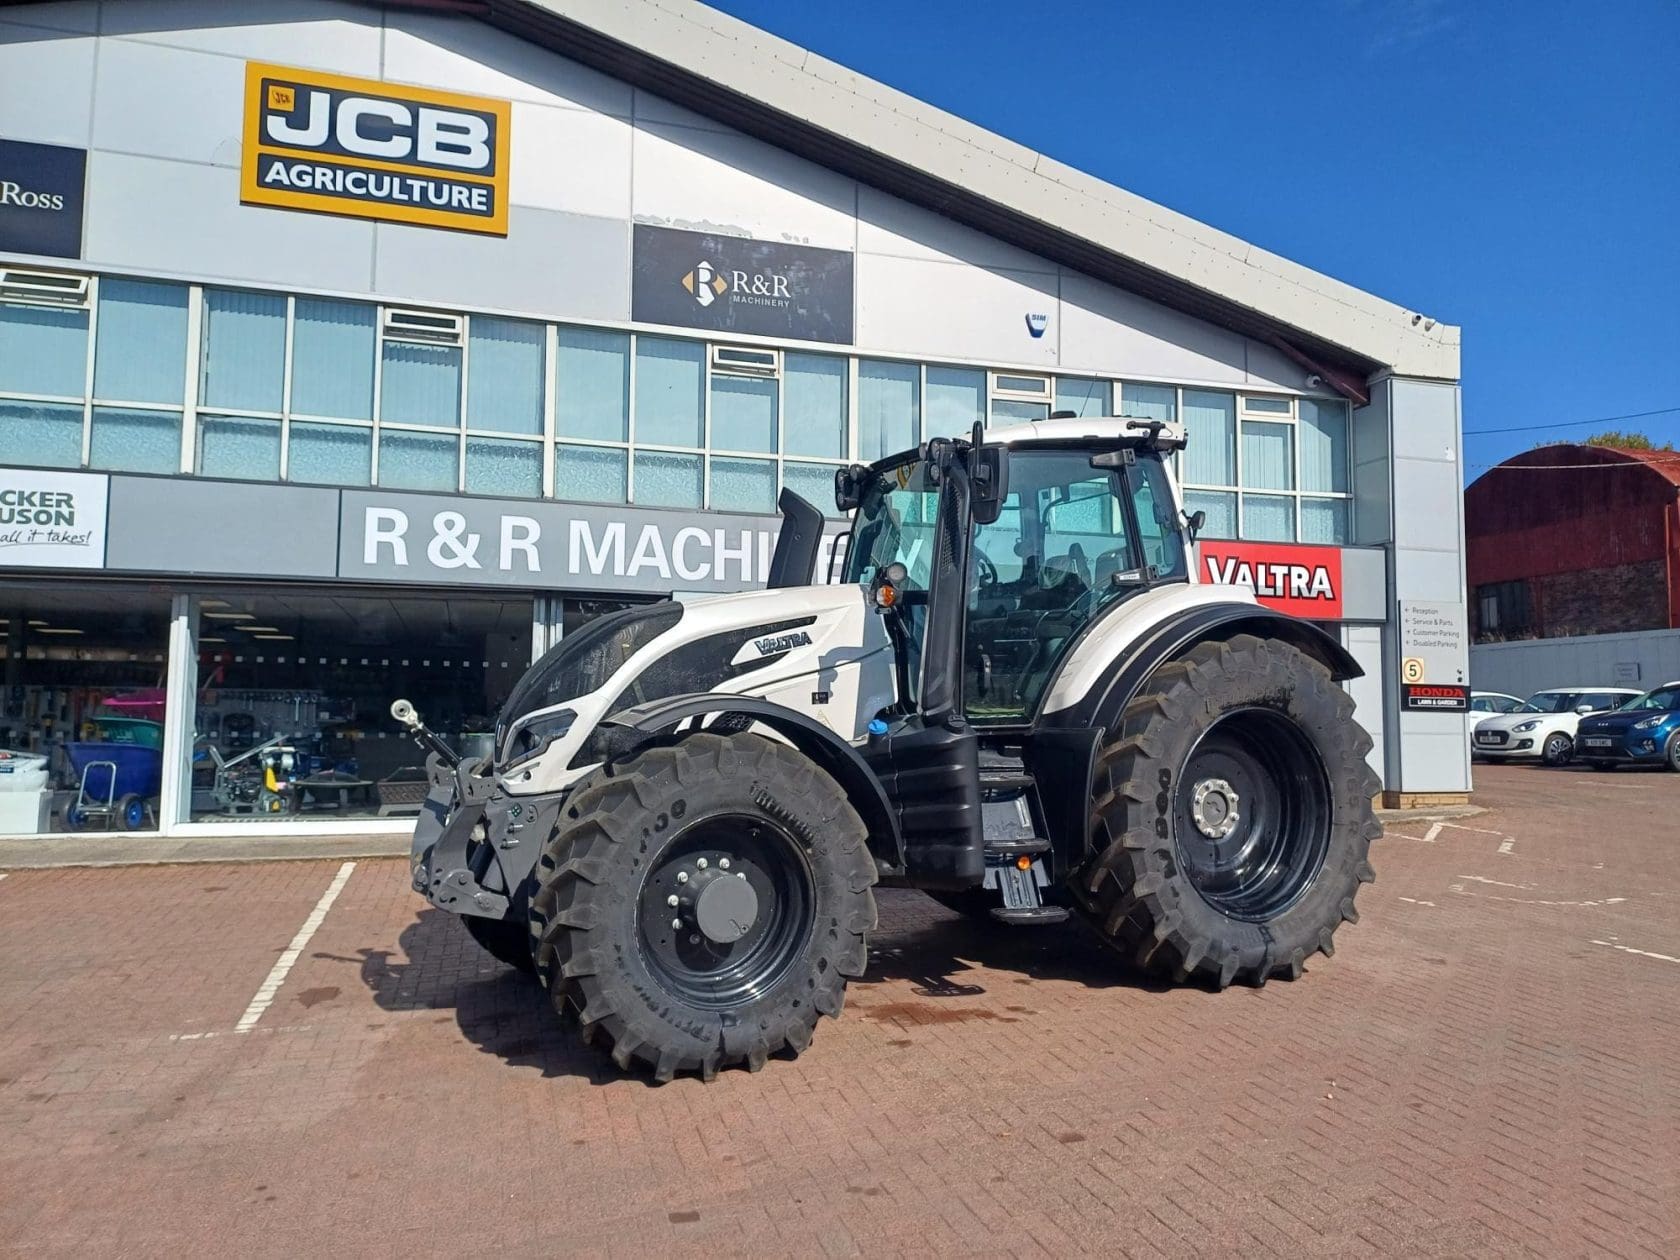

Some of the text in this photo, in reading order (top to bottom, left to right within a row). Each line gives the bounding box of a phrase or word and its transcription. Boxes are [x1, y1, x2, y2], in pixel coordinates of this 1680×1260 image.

[266, 90, 491, 170] JCB
[264, 161, 489, 212] AGRICULTURE
[732, 270, 792, 298] R&R
[733, 295, 790, 308] MACHINERY
[0, 489, 75, 509] CKER
[0, 508, 75, 526] USON
[0, 529, 92, 544] all it takes!
[364, 506, 409, 566] R
[427, 511, 482, 569] &
[500, 515, 541, 572] R
[1204, 555, 1336, 601] VALTRA
[1412, 606, 1439, 615] Reception
[1413, 617, 1433, 625] Service
[1440, 618, 1453, 627] Parts
[1413, 628, 1460, 639] Customer Parking
[754, 631, 813, 656] VALTRA
[1413, 639, 1458, 649] Disabled Parking
[1409, 664, 1417, 677] 5
[1410, 687, 1466, 697] HONDA
